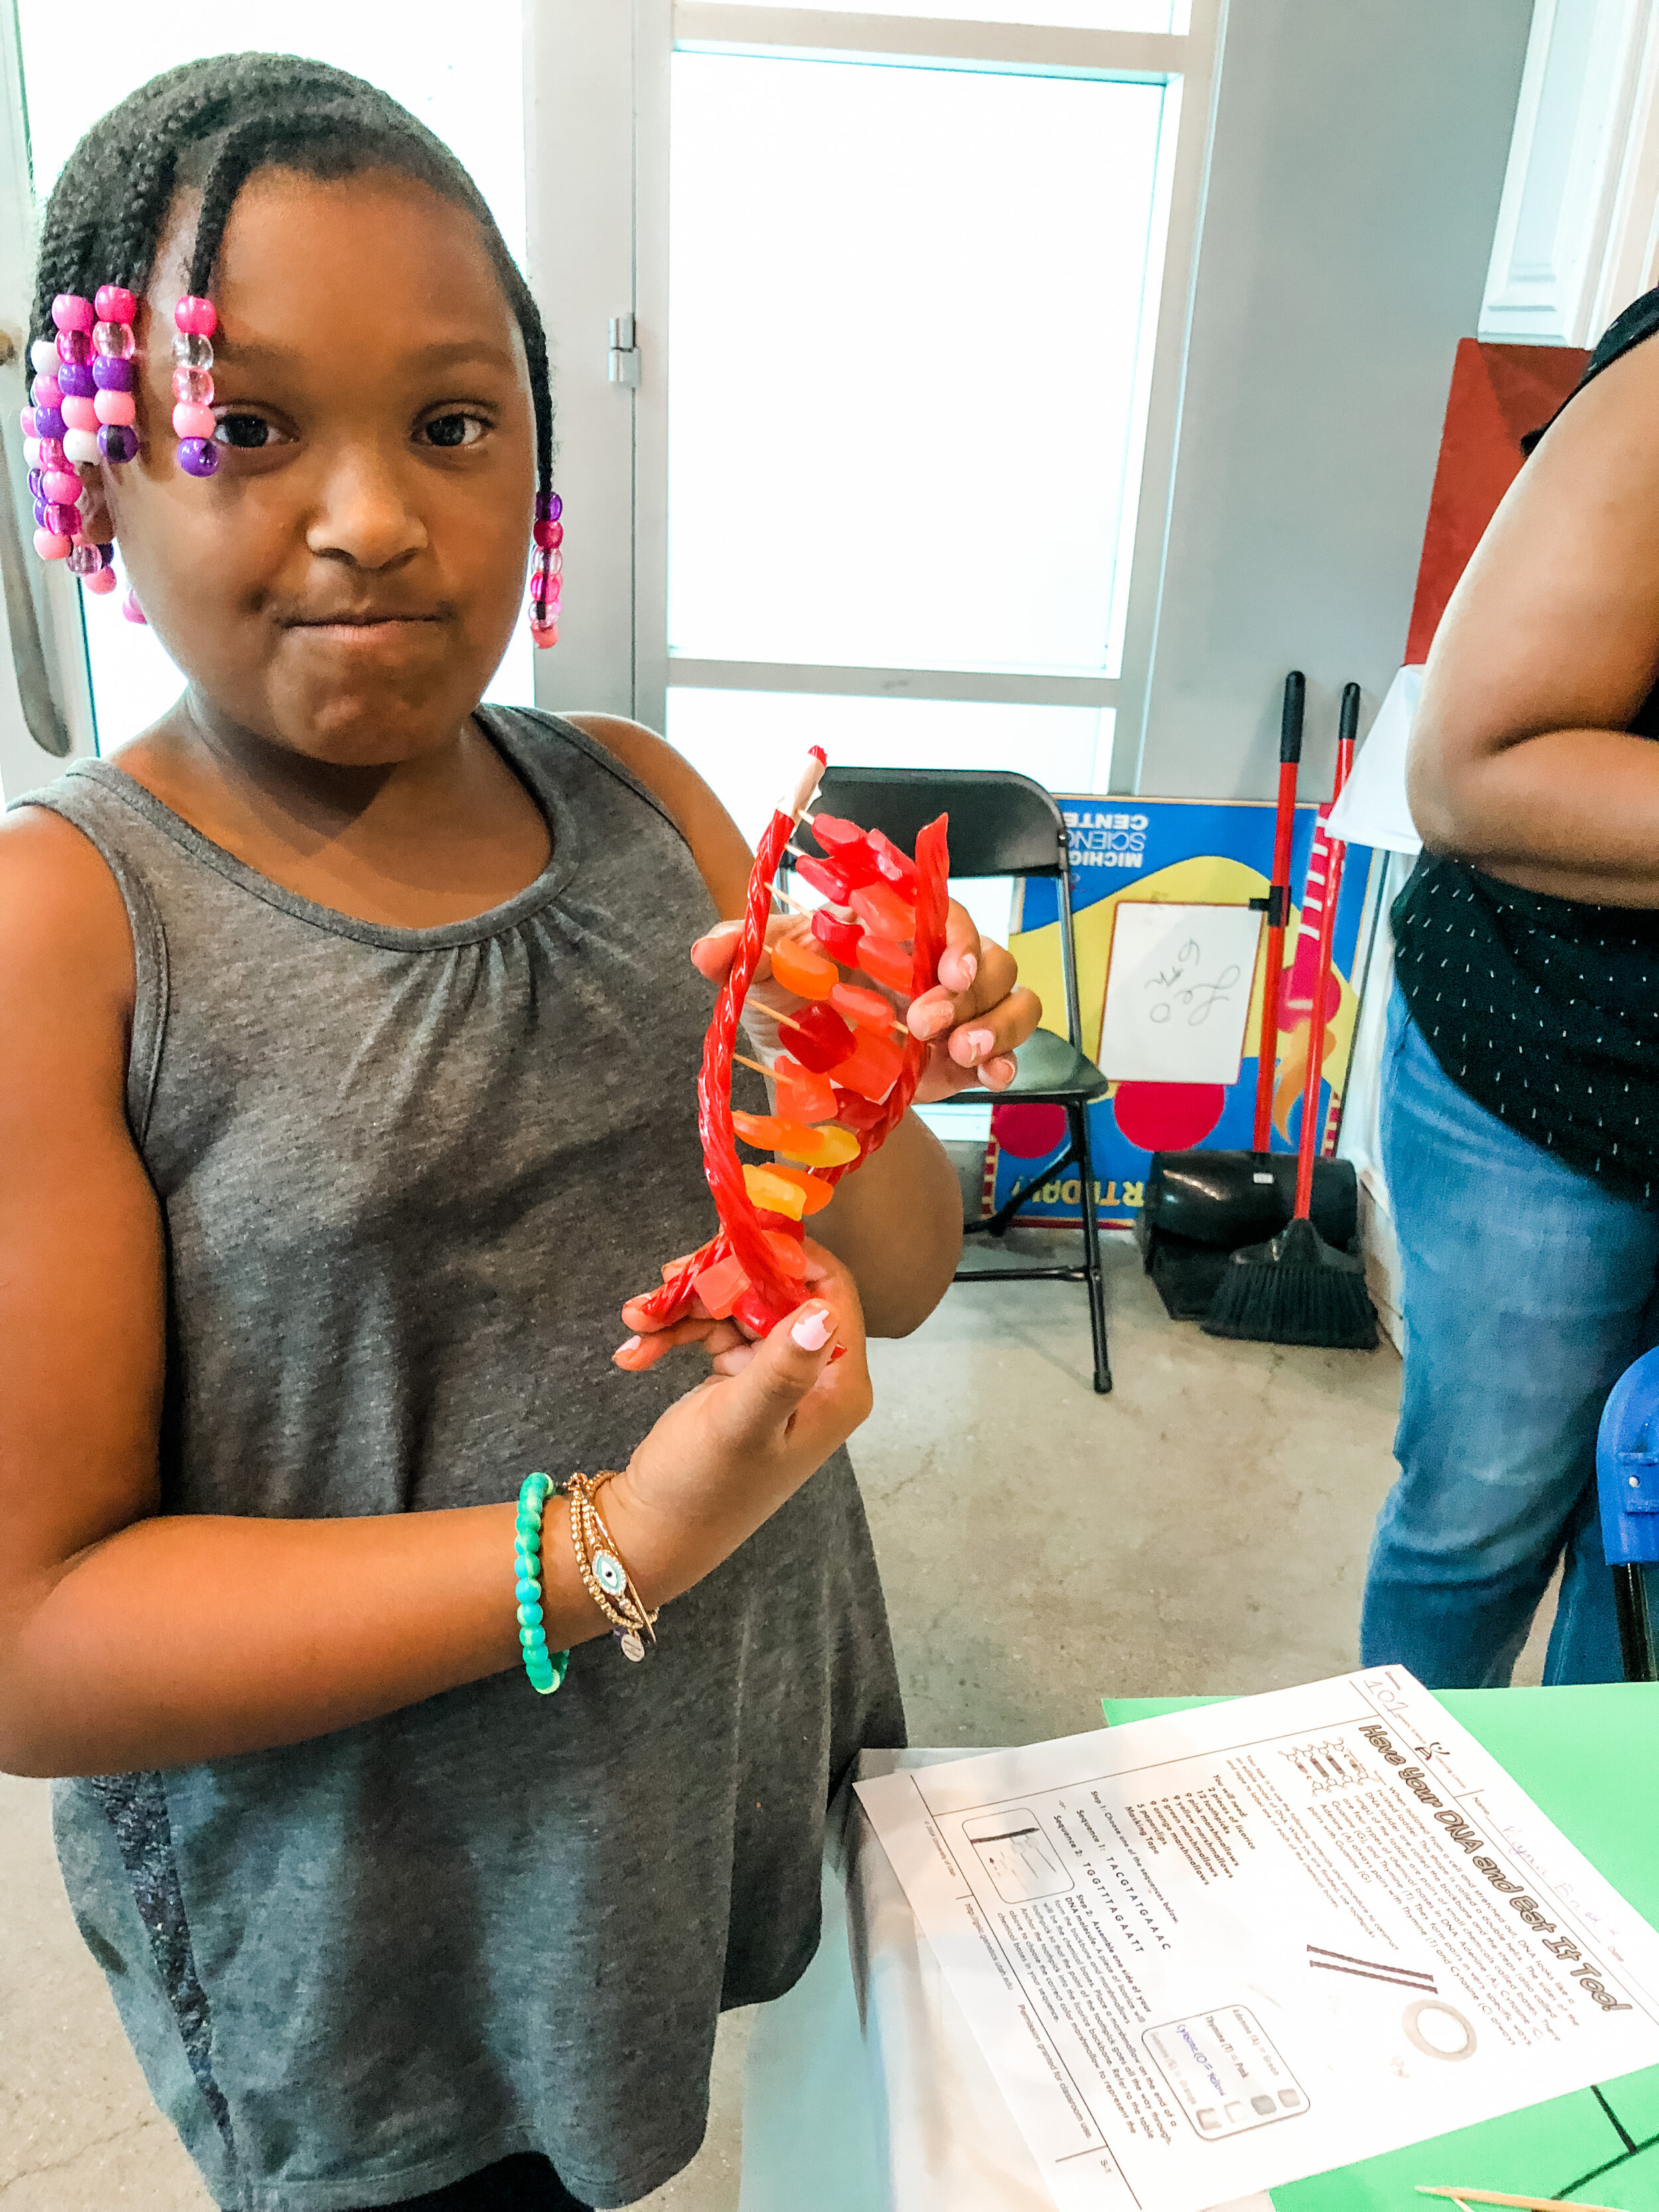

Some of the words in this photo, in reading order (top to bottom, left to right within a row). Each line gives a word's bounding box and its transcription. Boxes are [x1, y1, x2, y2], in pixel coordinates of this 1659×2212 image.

[1063, 812, 1149, 830] CENTE
[1068, 850, 1143, 867] MICHIG
[1076, 1809, 1100, 1842] Sequence
[1124, 1806, 1147, 1836] Masking
[1145, 1836, 1159, 1854] Tape
[1139, 1810, 1167, 1845] paperclips
[1187, 1799, 1203, 1814] pink
[1199, 1814, 1240, 1866] marshmallows
[1195, 1789, 1207, 1799] 12
[1202, 1799, 1230, 1834] toothpicks
[1210, 1793, 1230, 1814] pieces
[1234, 1824, 1256, 1850] licorice
[1212, 1774, 1224, 1786] You
[1222, 1787, 1236, 1799] will
[1230, 1801, 1248, 1818] need:
[1472, 1796, 1490, 1815] Name
[1053, 1814, 1076, 1848] Sequence
[1074, 1848, 1082, 1857] 2:
[1090, 1790, 1101, 1804] Step
[1104, 1812, 1121, 1834] Choose
[1119, 1835, 1129, 1848] one
[1132, 1856, 1141, 1867] the
[1140, 1868, 1164, 1901] sequences
[1163, 1901, 1179, 1924] below.
[1153, 1806, 1172, 1831] orange
[1169, 1832, 1209, 1885] marshmallows
[1163, 1804, 1181, 1824] green
[1179, 1824, 1218, 1877] marshmallows
[1175, 1801, 1196, 1824] yellow
[1193, 1826, 1234, 1878] marshmallows
[1306, 1806, 1323, 1823] pairs
[1323, 1824, 1336, 1839] with
[1334, 1840, 1359, 1869] Guanine
[1358, 1724, 1406, 1765] Have
[1398, 1767, 1443, 1808] Your
[1433, 1809, 1484, 1854] DNA
[1472, 1855, 1524, 1893] and
[1508, 1895, 1557, 1933] Eat
[1542, 1935, 1582, 1961] It
[1569, 1962, 1632, 2012] Too!
[1364, 1791, 1380, 1808] DNA
[1378, 1808, 1400, 1832] ladder
[1399, 1834, 1411, 1846] are
[1410, 1848, 1431, 1869] called
[1429, 1870, 1440, 1881] the
[1439, 1883, 1472, 1919] backbone
[1472, 1921, 1488, 1935] and
[1486, 1937, 1497, 1949] the
[1497, 1951, 1516, 1971] steps
[1534, 1994, 1557, 2018] called
[1376, 1789, 1400, 1812] twisted
[1419, 1839, 1430, 1853] This
[1429, 1854, 1449, 1875] shape
[1455, 1884, 1478, 1906] called
[1481, 1915, 1505, 1941] double
[1526, 1965, 1538, 1979] The
[1538, 1982, 1556, 2001] sides
[1567, 2014, 1579, 2026] the
[1388, 1786, 1406, 1806] When
[1405, 1807, 1431, 1834] isolated
[1429, 1836, 1443, 1852] from
[1449, 1860, 1463, 1872] cell
[1461, 1874, 1477, 1888] and
[1474, 1889, 1506, 1923] stretched
[1504, 1925, 1517, 1938] out,
[1517, 1939, 1536, 1958] DNA
[1535, 1960, 1554, 1980] looks
[1555, 1982, 1567, 1995] like
[997, 1912, 1018, 1941] chemical
[1013, 1941, 1027, 1962] bases
[1027, 1970, 1041, 1986] your
[1038, 1987, 1058, 2022] sequence.
[1054, 1899, 1065, 1915] form
[1063, 1915, 1072, 1926] the
[1070, 1927, 1092, 1959] backbone
[1090, 1961, 1103, 1974] and
[1099, 1976, 1130, 2024] marshmallows
[1064, 1896, 1078, 1913] DNA
[1075, 1915, 1096, 1947] molecule.
[1097, 1954, 1113, 1973] piece
[1118, 1984, 1135, 2009] licorice
[1133, 2010, 1145, 2023] will
[1076, 1893, 1087, 1909] Step
[1091, 1921, 1114, 1953] Assemble
[1112, 1954, 1123, 1968] one
[1121, 1969, 1133, 1984] side
[1135, 1996, 1151, 2012] your
[1017, 2004, 1041, 2043] Permission
[1036, 2042, 1059, 2071] granted
[1052, 2069, 1065, 2081] for
[1059, 2082, 1084, 2123] classroom
